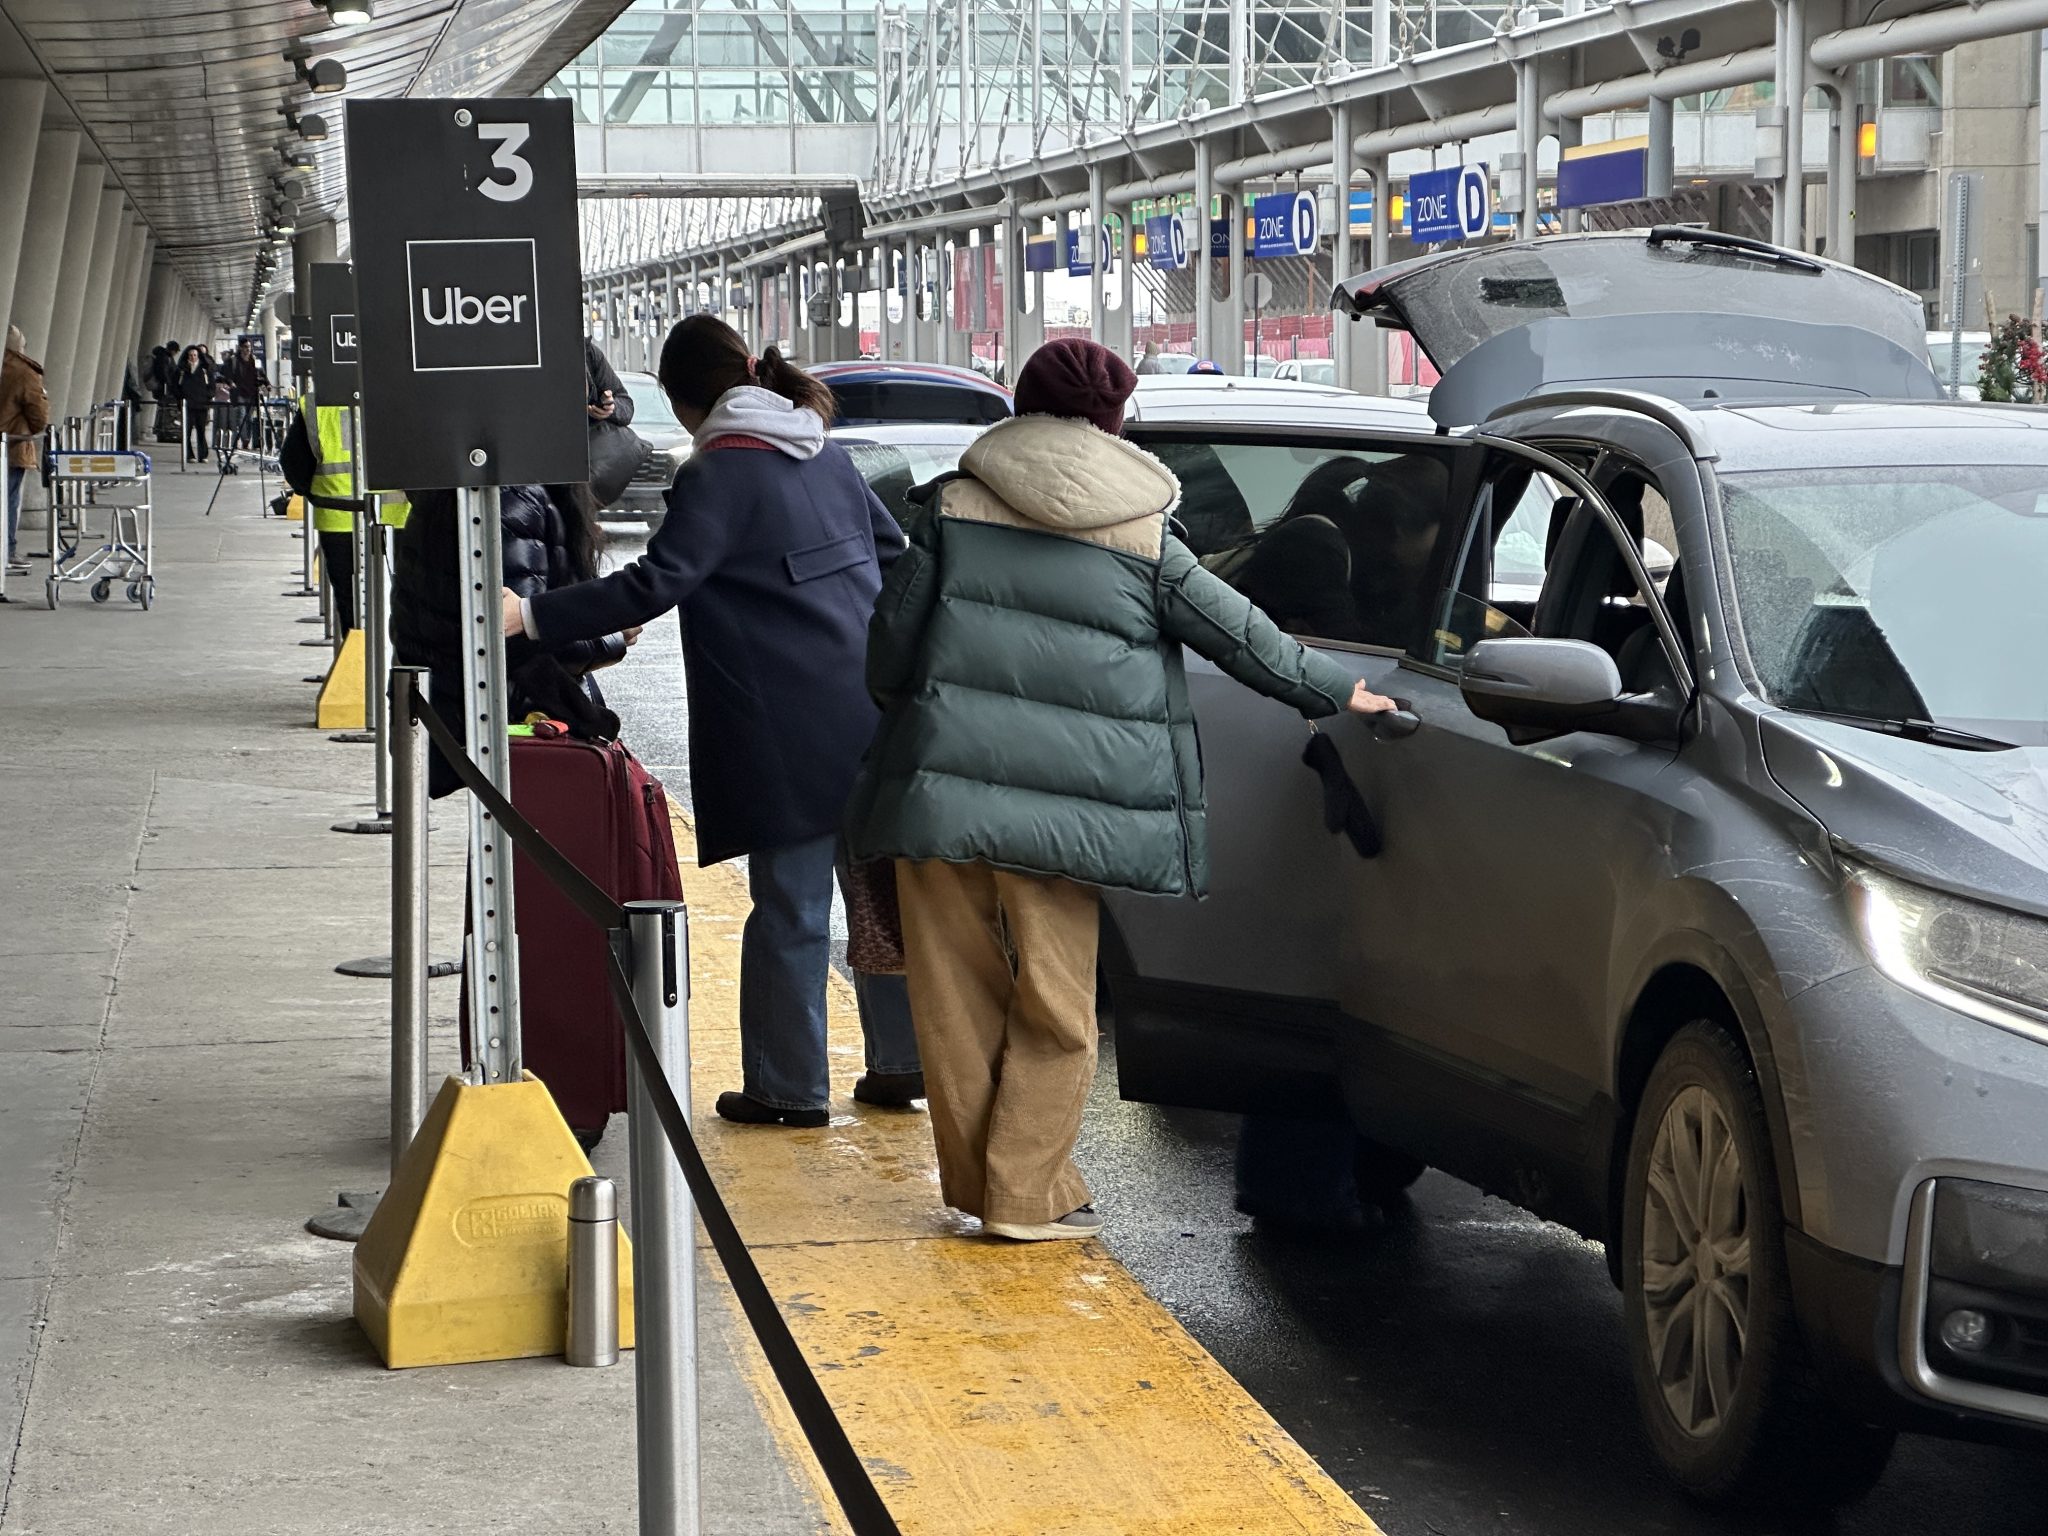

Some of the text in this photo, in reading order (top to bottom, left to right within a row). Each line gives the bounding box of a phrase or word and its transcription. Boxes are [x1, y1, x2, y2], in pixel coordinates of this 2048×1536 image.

[477, 122, 534, 202] 3
[1259, 198, 1315, 250] ZONE D
[1417, 172, 1486, 233] ZONE D
[1150, 219, 1186, 264] ZONE D
[421, 286, 527, 326] Uber
[300, 343, 313, 352] Ub
[336, 331, 357, 348] Ub
